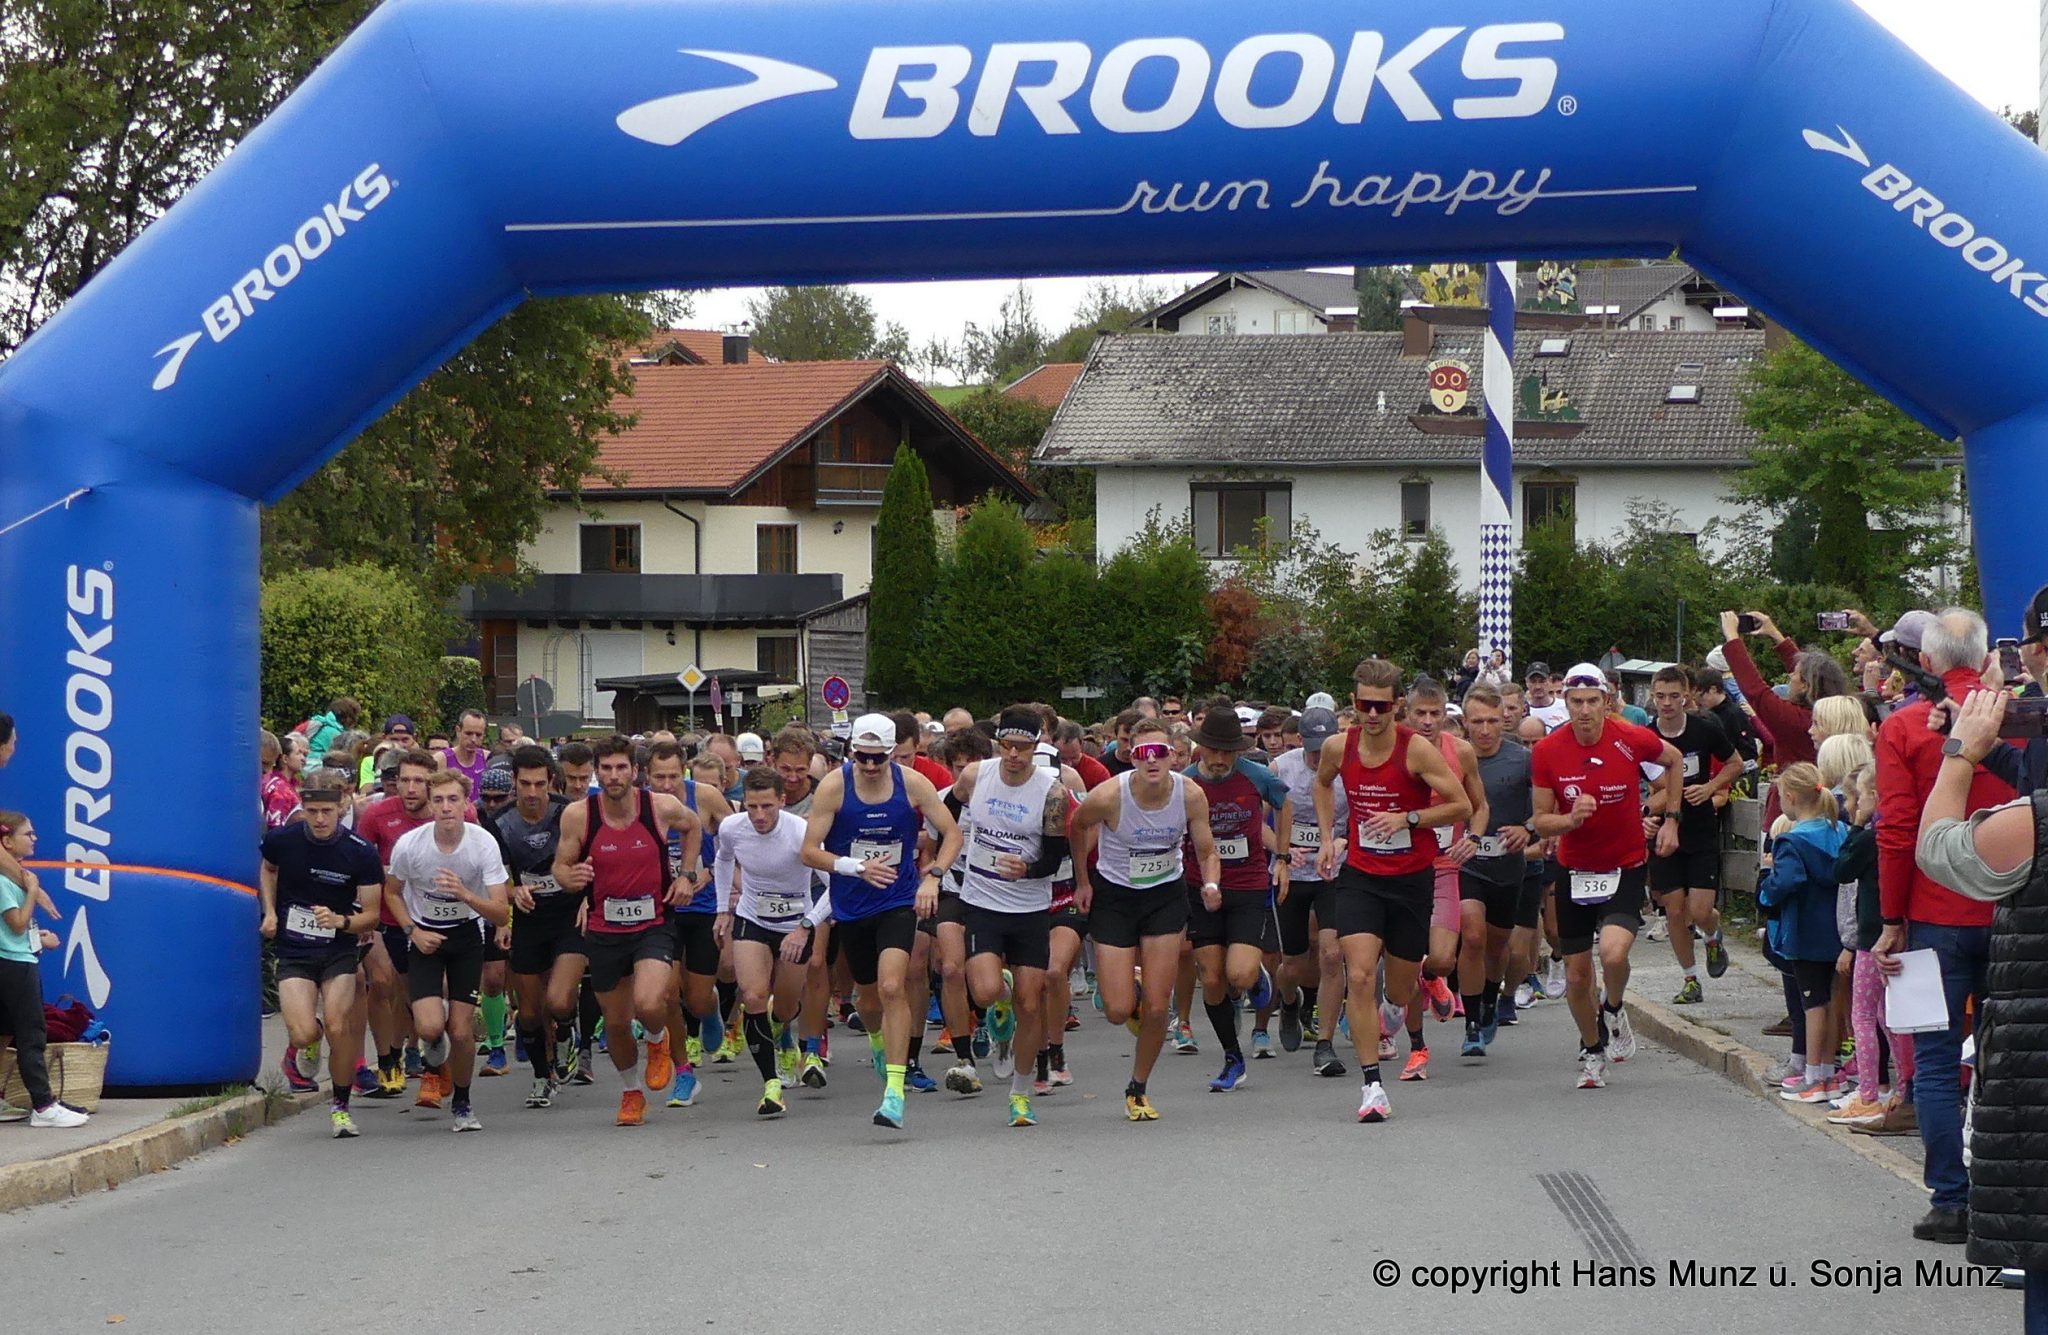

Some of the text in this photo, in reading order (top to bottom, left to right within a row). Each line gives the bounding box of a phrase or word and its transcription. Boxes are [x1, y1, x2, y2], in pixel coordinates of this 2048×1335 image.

[1121, 161, 1552, 217] run happy
[202, 163, 390, 343] BROOKS
[1359, 784, 1387, 792] Triathlon
[1599, 784, 1627, 793] Triathlon
[1210, 812, 1237, 821] ALPINE
[1299, 831, 1321, 842] 308
[1215, 845, 1236, 855] 80
[1584, 879, 1608, 893] 536
[434, 906, 458, 917] 555
[617, 905, 642, 917] 416
[769, 901, 792, 914] 581
